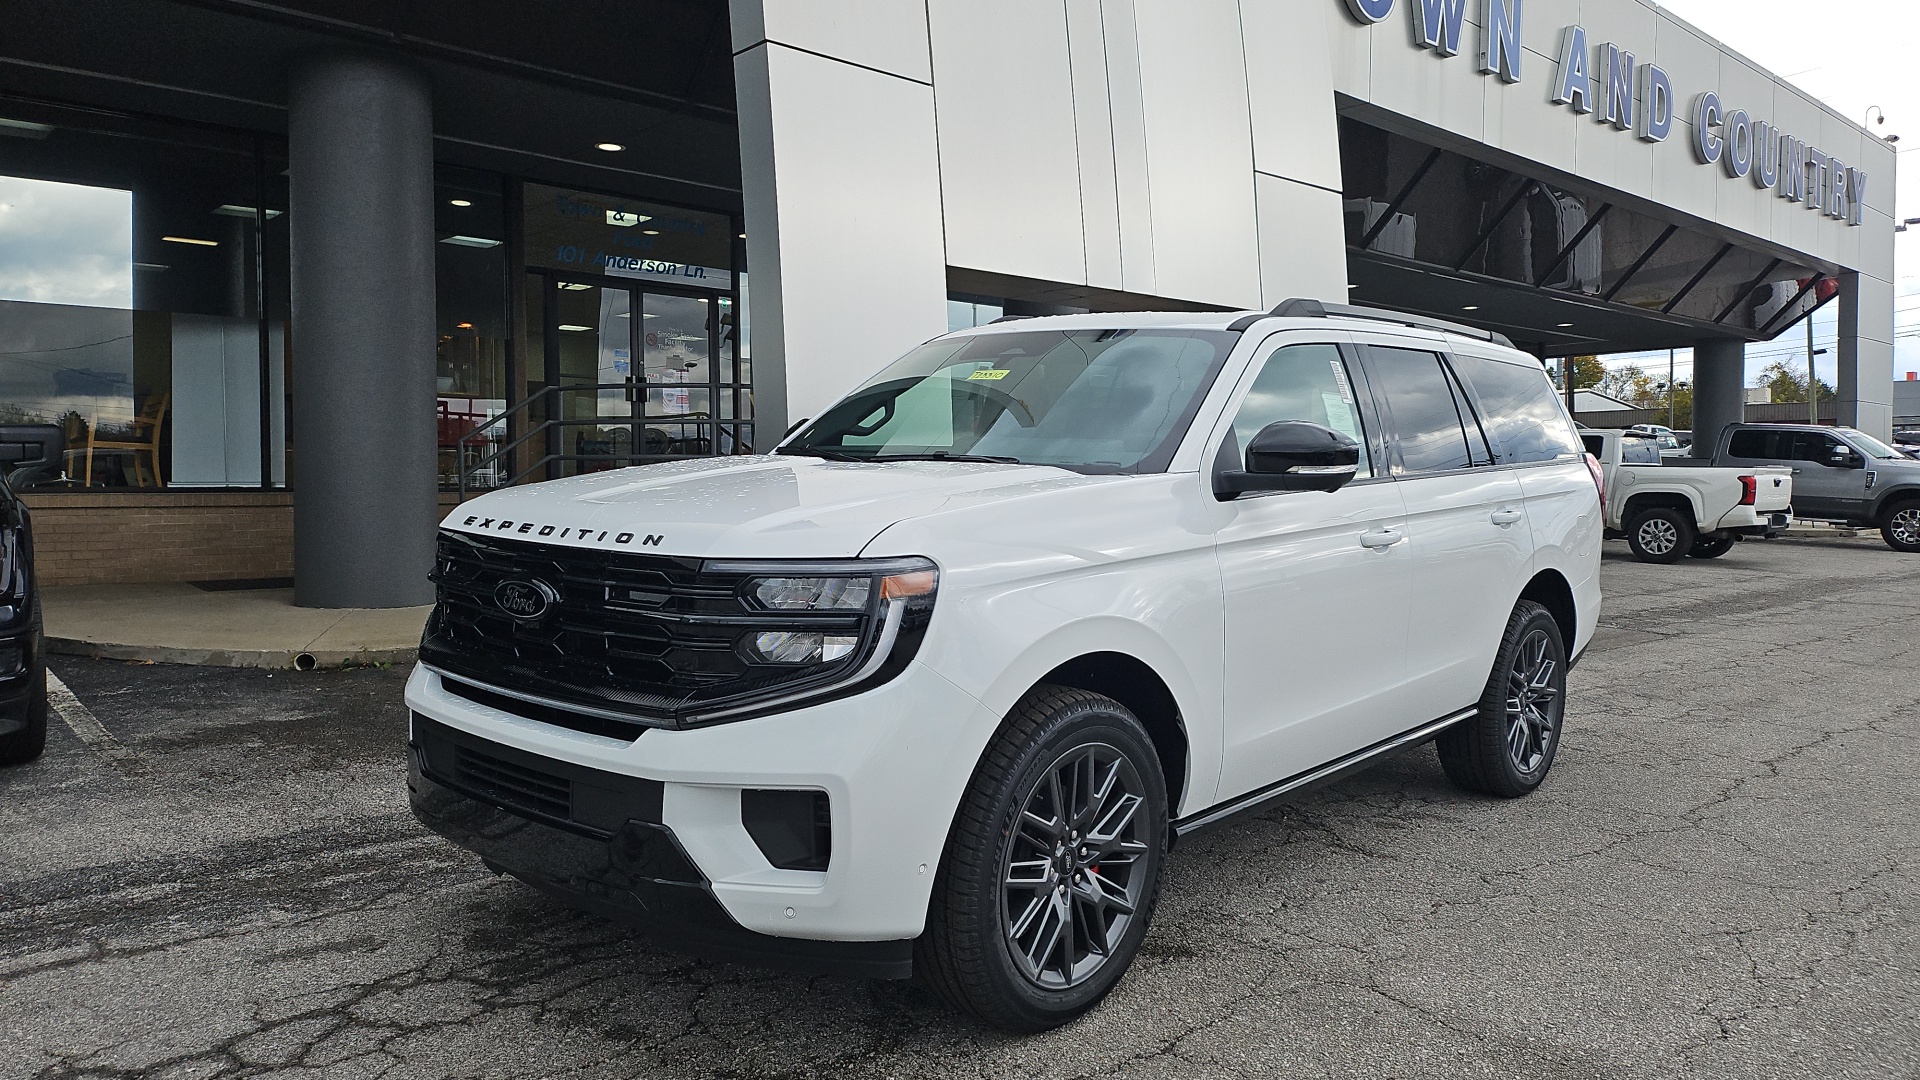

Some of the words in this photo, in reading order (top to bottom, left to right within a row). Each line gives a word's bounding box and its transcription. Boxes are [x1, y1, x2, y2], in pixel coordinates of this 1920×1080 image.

[1346, 0, 1523, 84] WN
[1553, 25, 1674, 143] AND
[1692, 91, 1868, 227] COUNTRY
[613, 205, 625, 222] &
[556, 244, 586, 265] 101
[593, 250, 677, 276] Anderson
[684, 262, 707, 280] Ln.
[463, 515, 664, 547] EXPEDITION
[504, 584, 537, 613] Ford
[989, 799, 1018, 900] MICHELIN
